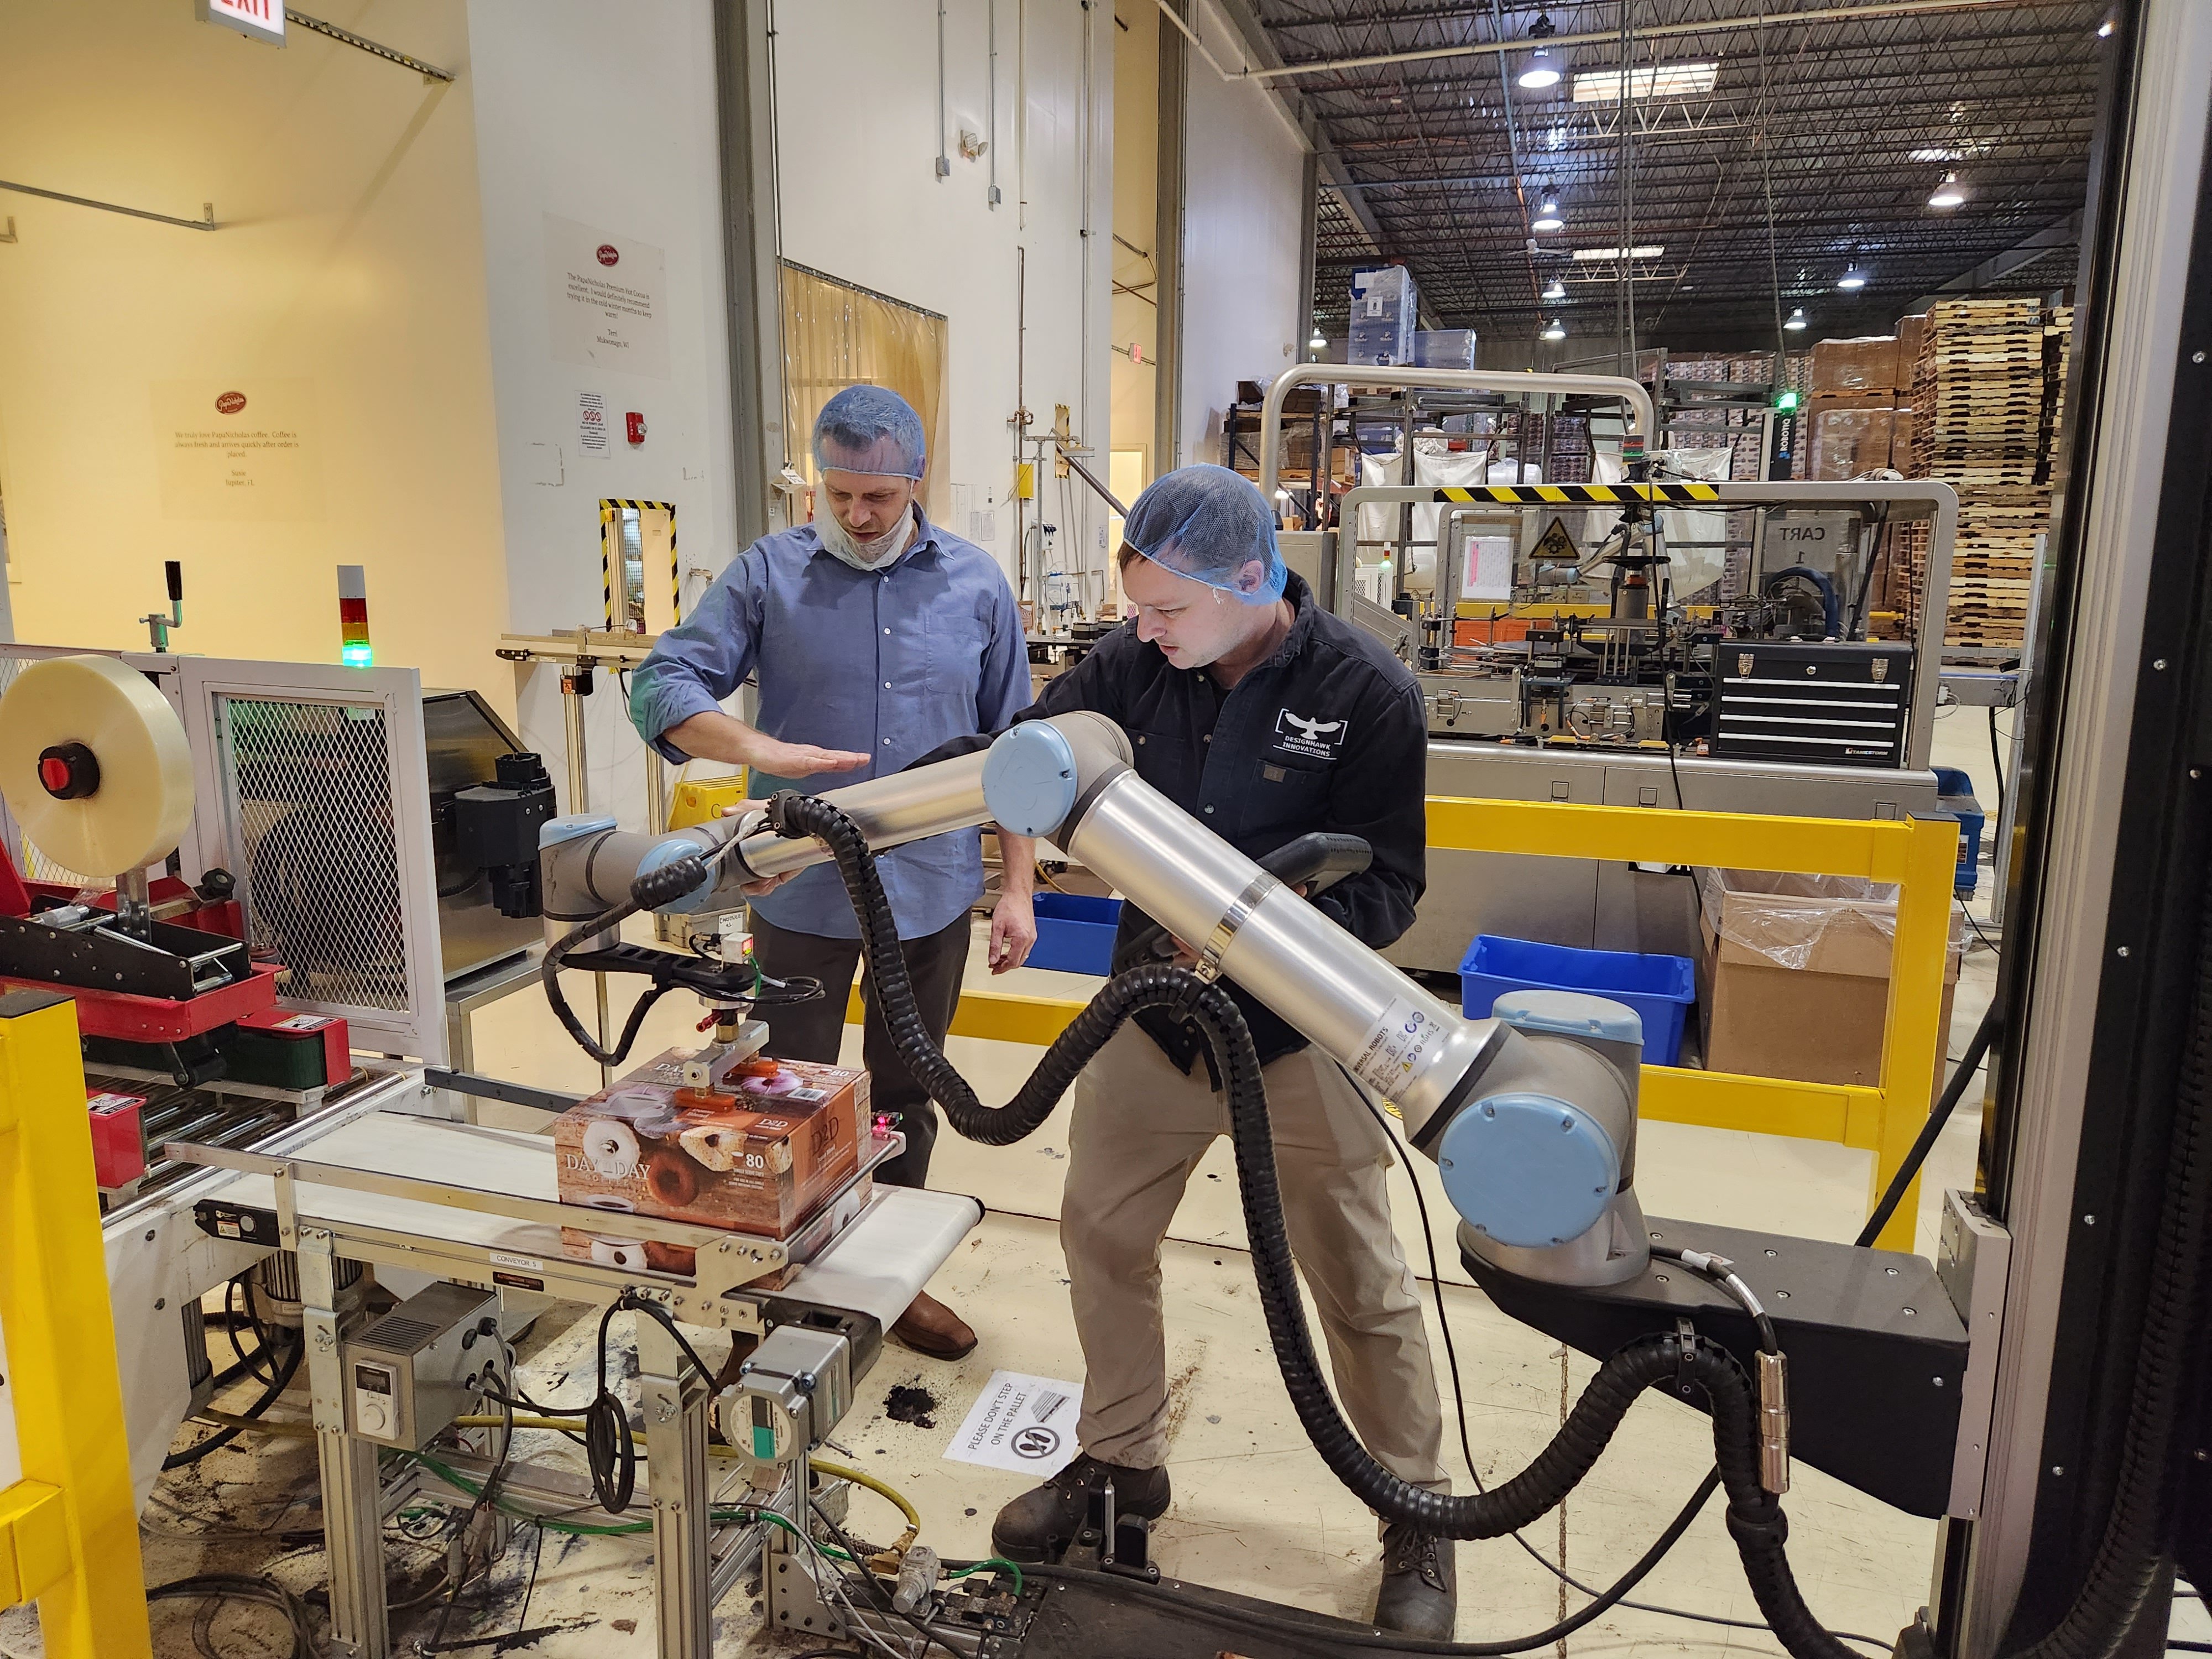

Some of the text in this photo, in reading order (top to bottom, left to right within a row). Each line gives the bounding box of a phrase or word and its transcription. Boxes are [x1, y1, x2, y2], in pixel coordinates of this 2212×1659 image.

[567, 272, 576, 280] The
[606, 283, 625, 294] Premium
[633, 290, 645, 299] Cocoa
[567, 292, 581, 302] trying
[599, 299, 608, 307] cold
[622, 306, 637, 315] months
[593, 290, 606, 298] would
[607, 291, 626, 304] definitely
[627, 298, 650, 309] recommend
[607, 328, 618, 337] Terri
[184, 431, 198, 440] truly
[212, 431, 250, 440] PapaNicholas
[1780, 418, 1791, 451] ROBOTIQ
[241, 441, 261, 451] quickly
[1282, 741, 1331, 757] INNOVATIONS
[1285, 735, 1331, 750] DESIGNHAWK
[1369, 1026, 1389, 1050] ROBOTS
[654, 1063, 684, 1073] DA
[758, 1118, 789, 1128] D2D
[565, 1154, 599, 1173] DAY
[614, 1161, 651, 1180] DAY
[745, 1154, 764, 1168] 80
[497, 1255, 529, 1266] CONVEYOR
[968, 1383, 1013, 1451] PLEASE DON'T STEP
[991, 1392, 1027, 1446] ON THE PALLET
